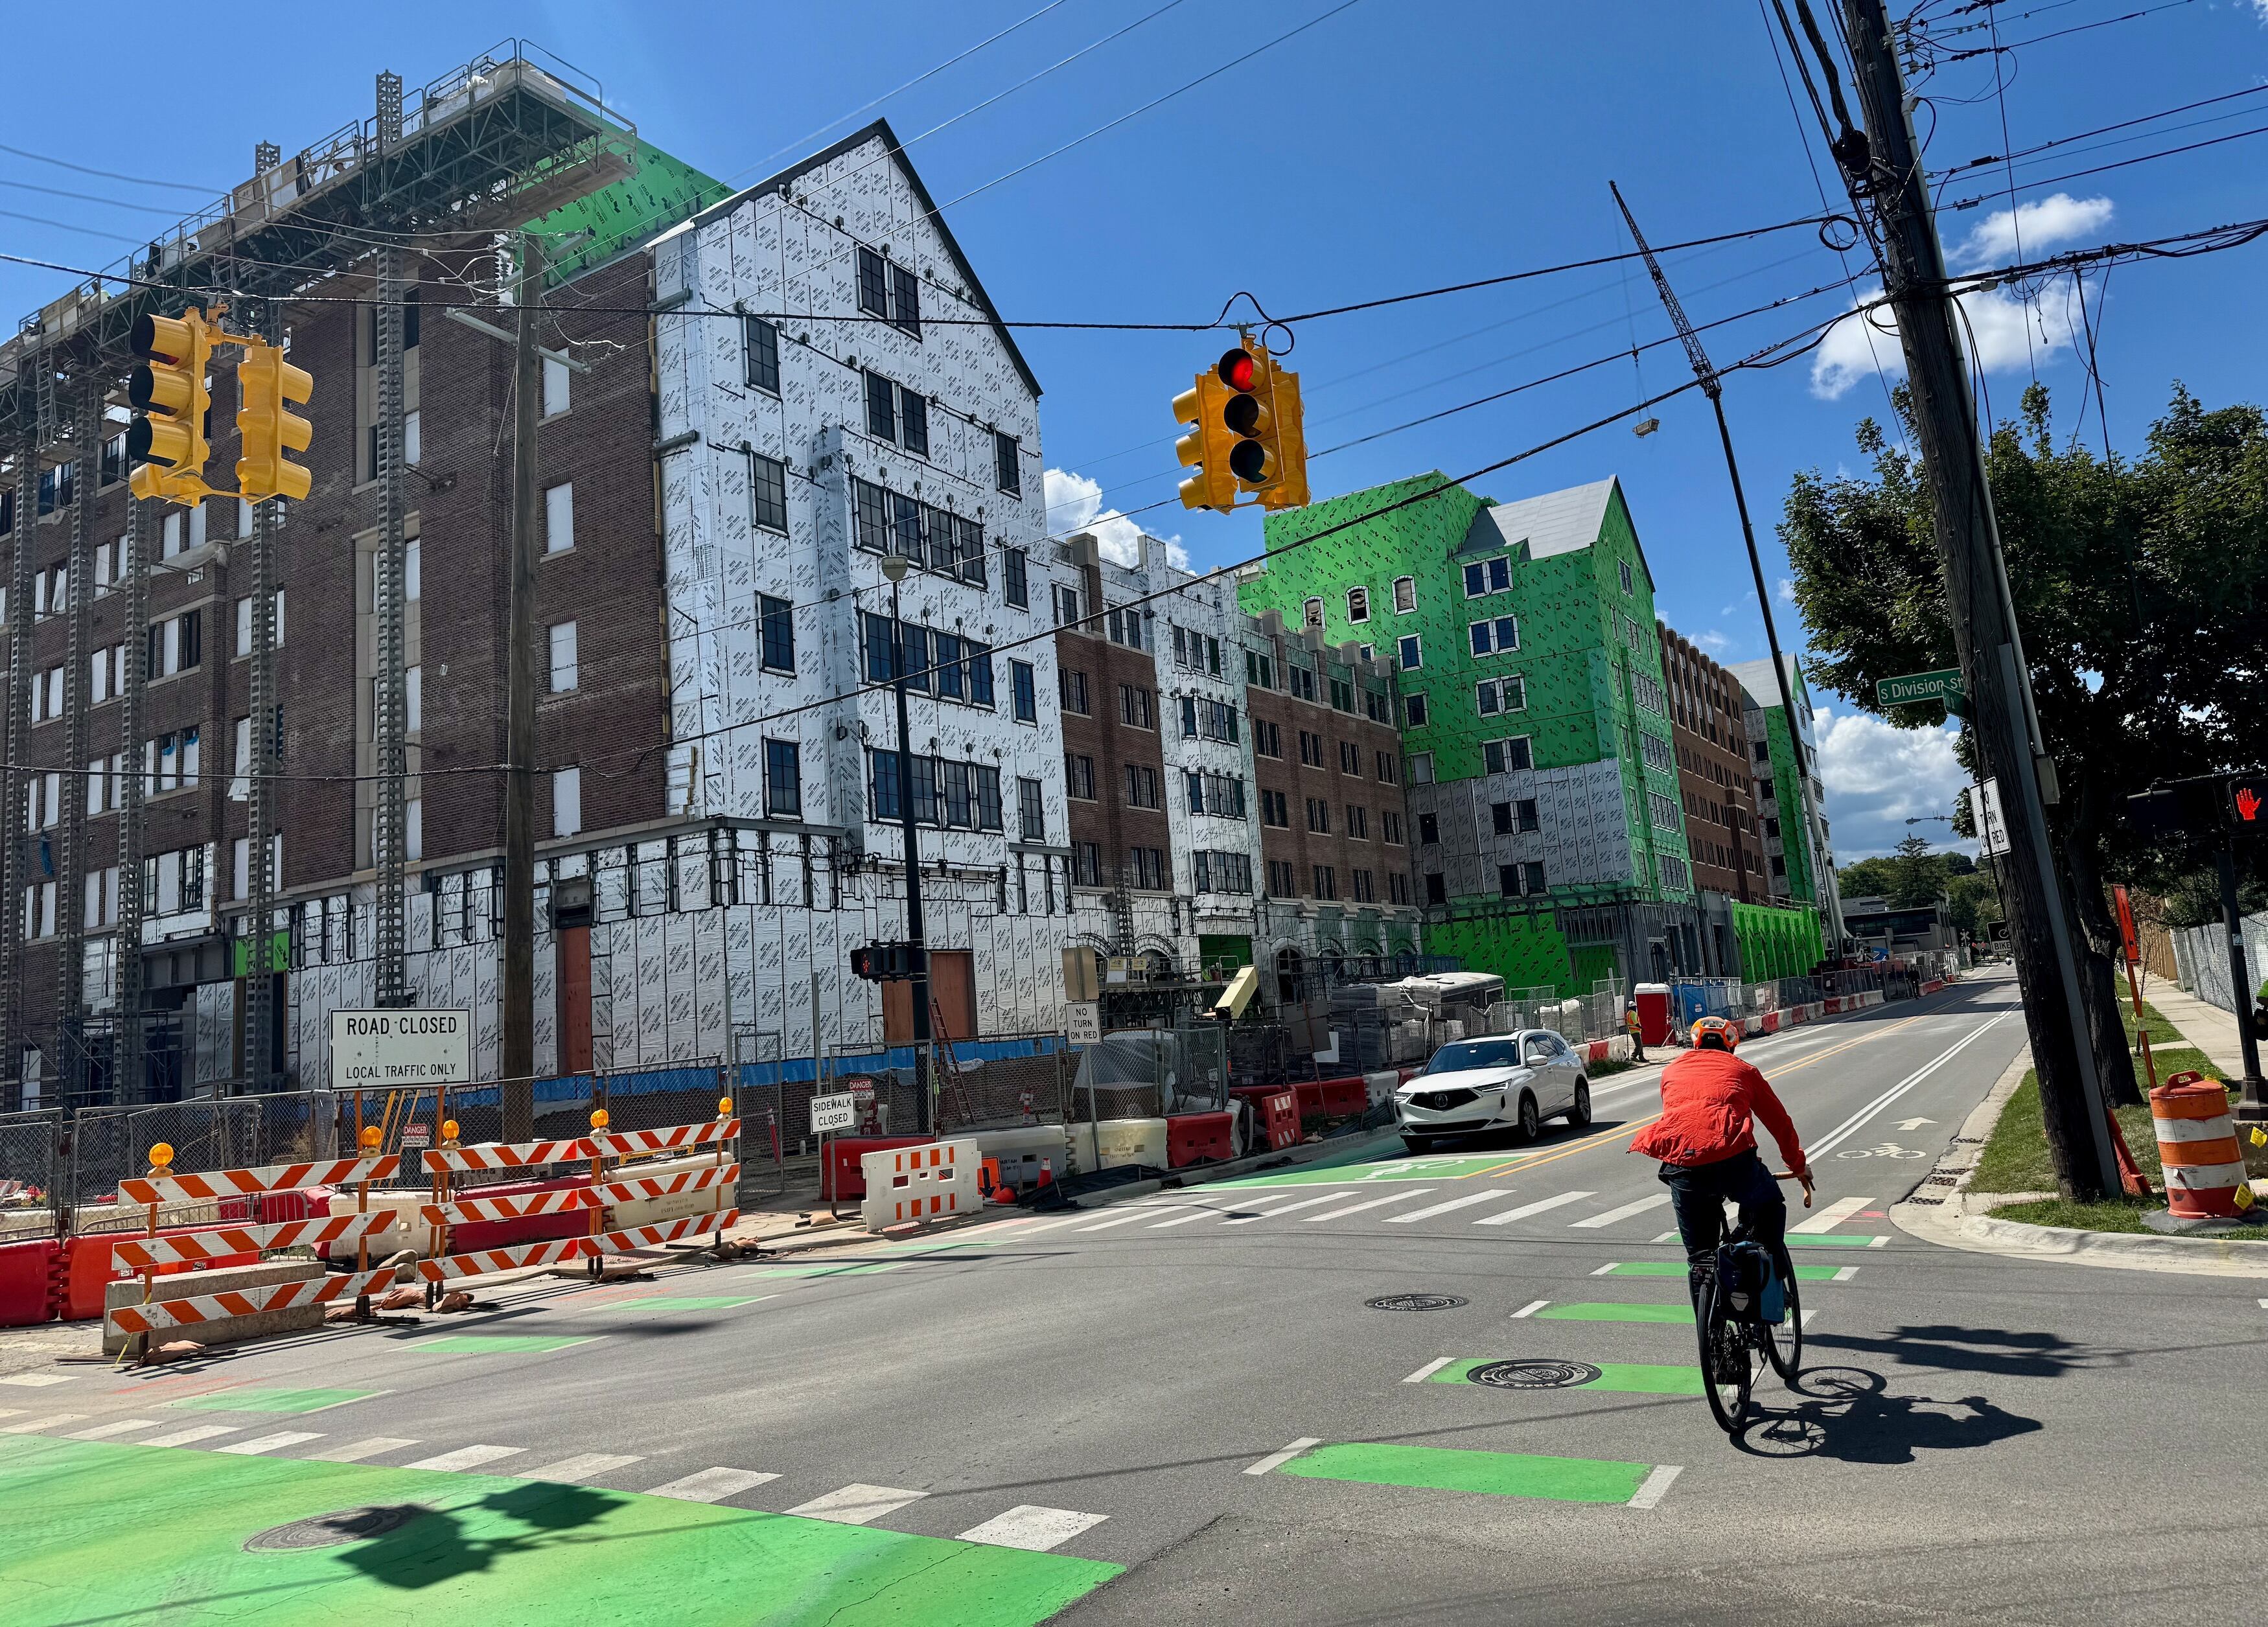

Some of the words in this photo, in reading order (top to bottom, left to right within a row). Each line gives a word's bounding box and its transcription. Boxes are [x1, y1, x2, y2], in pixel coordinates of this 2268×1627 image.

[605, 190, 614, 202] USG
[640, 184, 650, 196] USG
[576, 202, 586, 214] USG
[632, 205, 642, 216] USG
[596, 211, 605, 224] USG
[1880, 688, 1888, 699] S
[1891, 679, 1944, 698] Division
[1980, 809, 1998, 827] TRN
[1992, 829, 2005, 845] RED
[1076, 1008, 1087, 1016] NO
[347, 1018, 389, 1035] ROAD
[400, 1017, 457, 1034] CLOSED
[1073, 1019, 1093, 1028] TURN
[1083, 1031, 1097, 1039] RED
[346, 1066, 380, 1079] LOCAL
[385, 1064, 426, 1078] TRAFFIC
[431, 1063, 456, 1076] ONLY
[850, 1081, 872, 1089] DANGER
[814, 1098, 851, 1112] SIDEWALK
[818, 1113, 848, 1126] CLOSED
